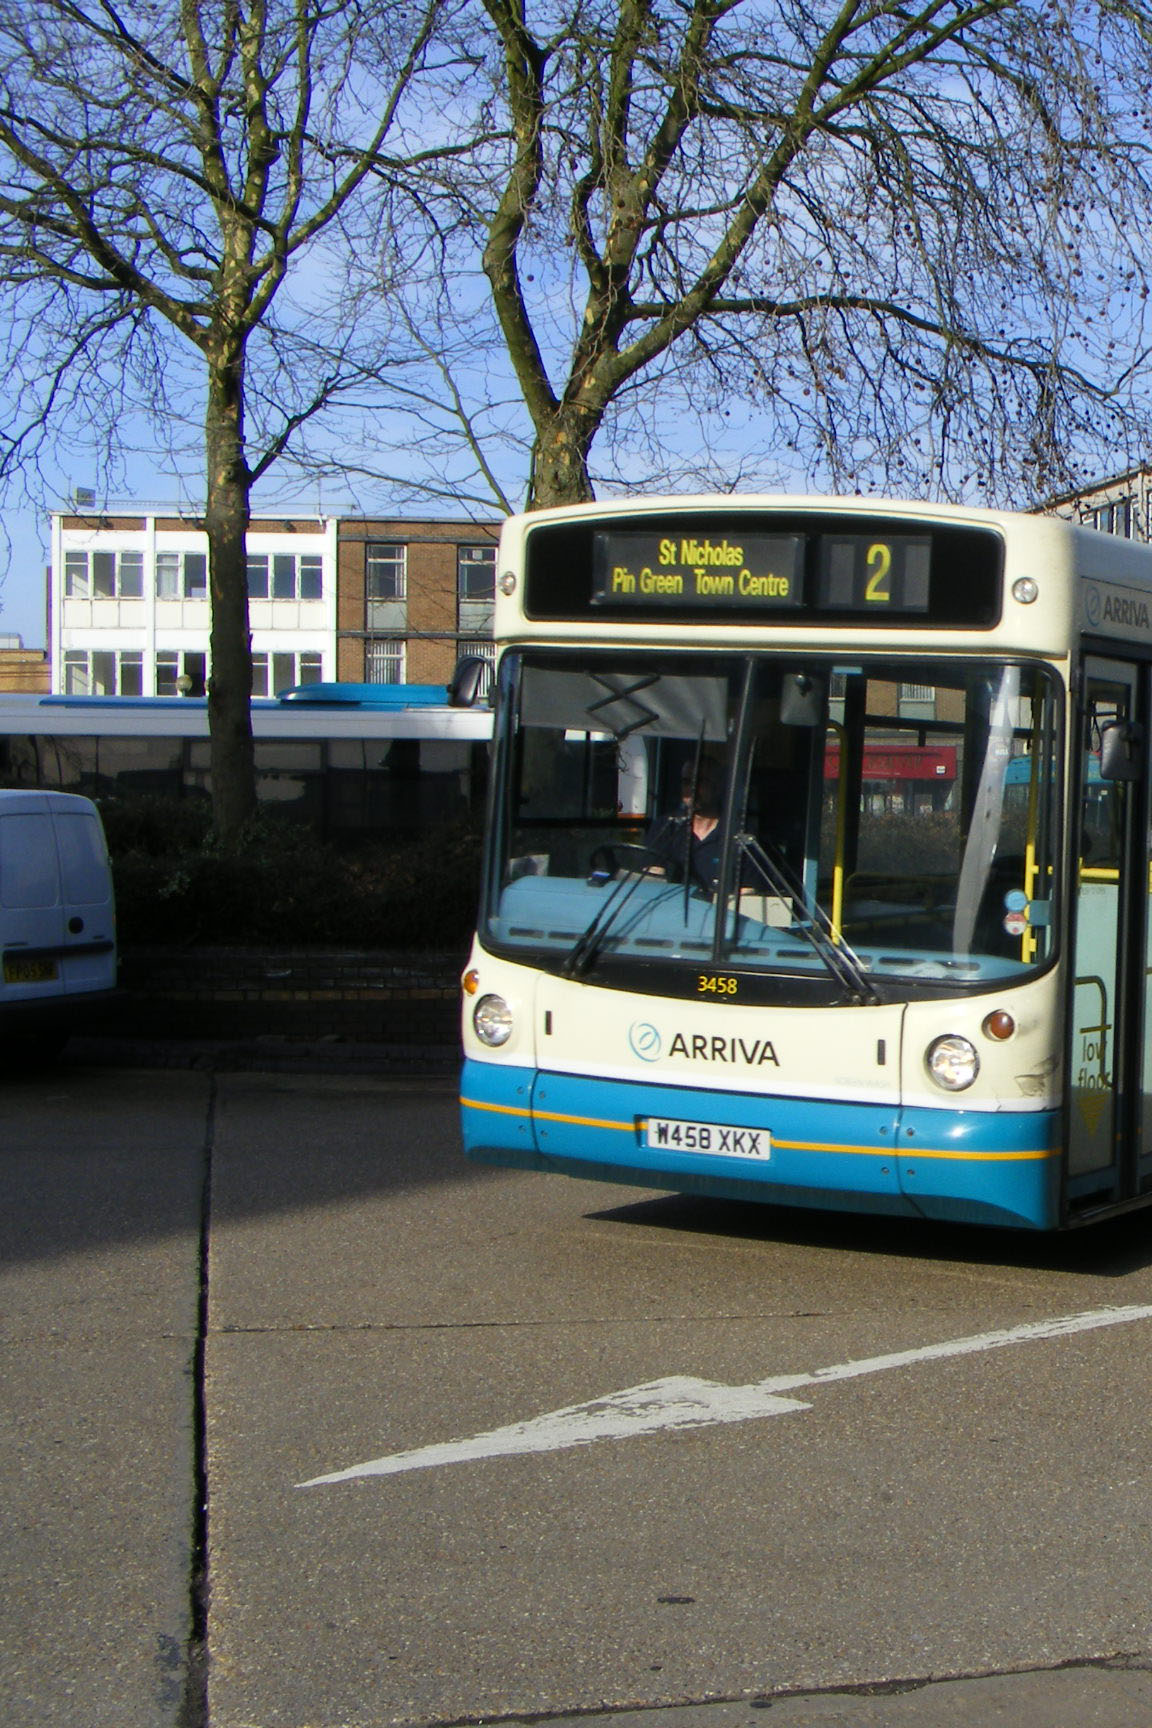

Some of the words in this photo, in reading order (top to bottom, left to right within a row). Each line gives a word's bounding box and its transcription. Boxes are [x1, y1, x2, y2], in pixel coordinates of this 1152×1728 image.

[658, 539, 677, 565] St
[681, 539, 744, 566] Nicholas
[612, 567, 636, 593] Pin
[640, 567, 683, 594] Green
[693, 569, 734, 595] Town
[738, 569, 789, 596] Centre
[865, 543, 891, 601] 2
[1103, 595, 1150, 629] ARRIVA
[697, 975, 738, 995] 3458
[668, 1033, 781, 1067] ARRIVA
[656, 1122, 711, 1150] W458
[718, 1129, 761, 1155] XKX
